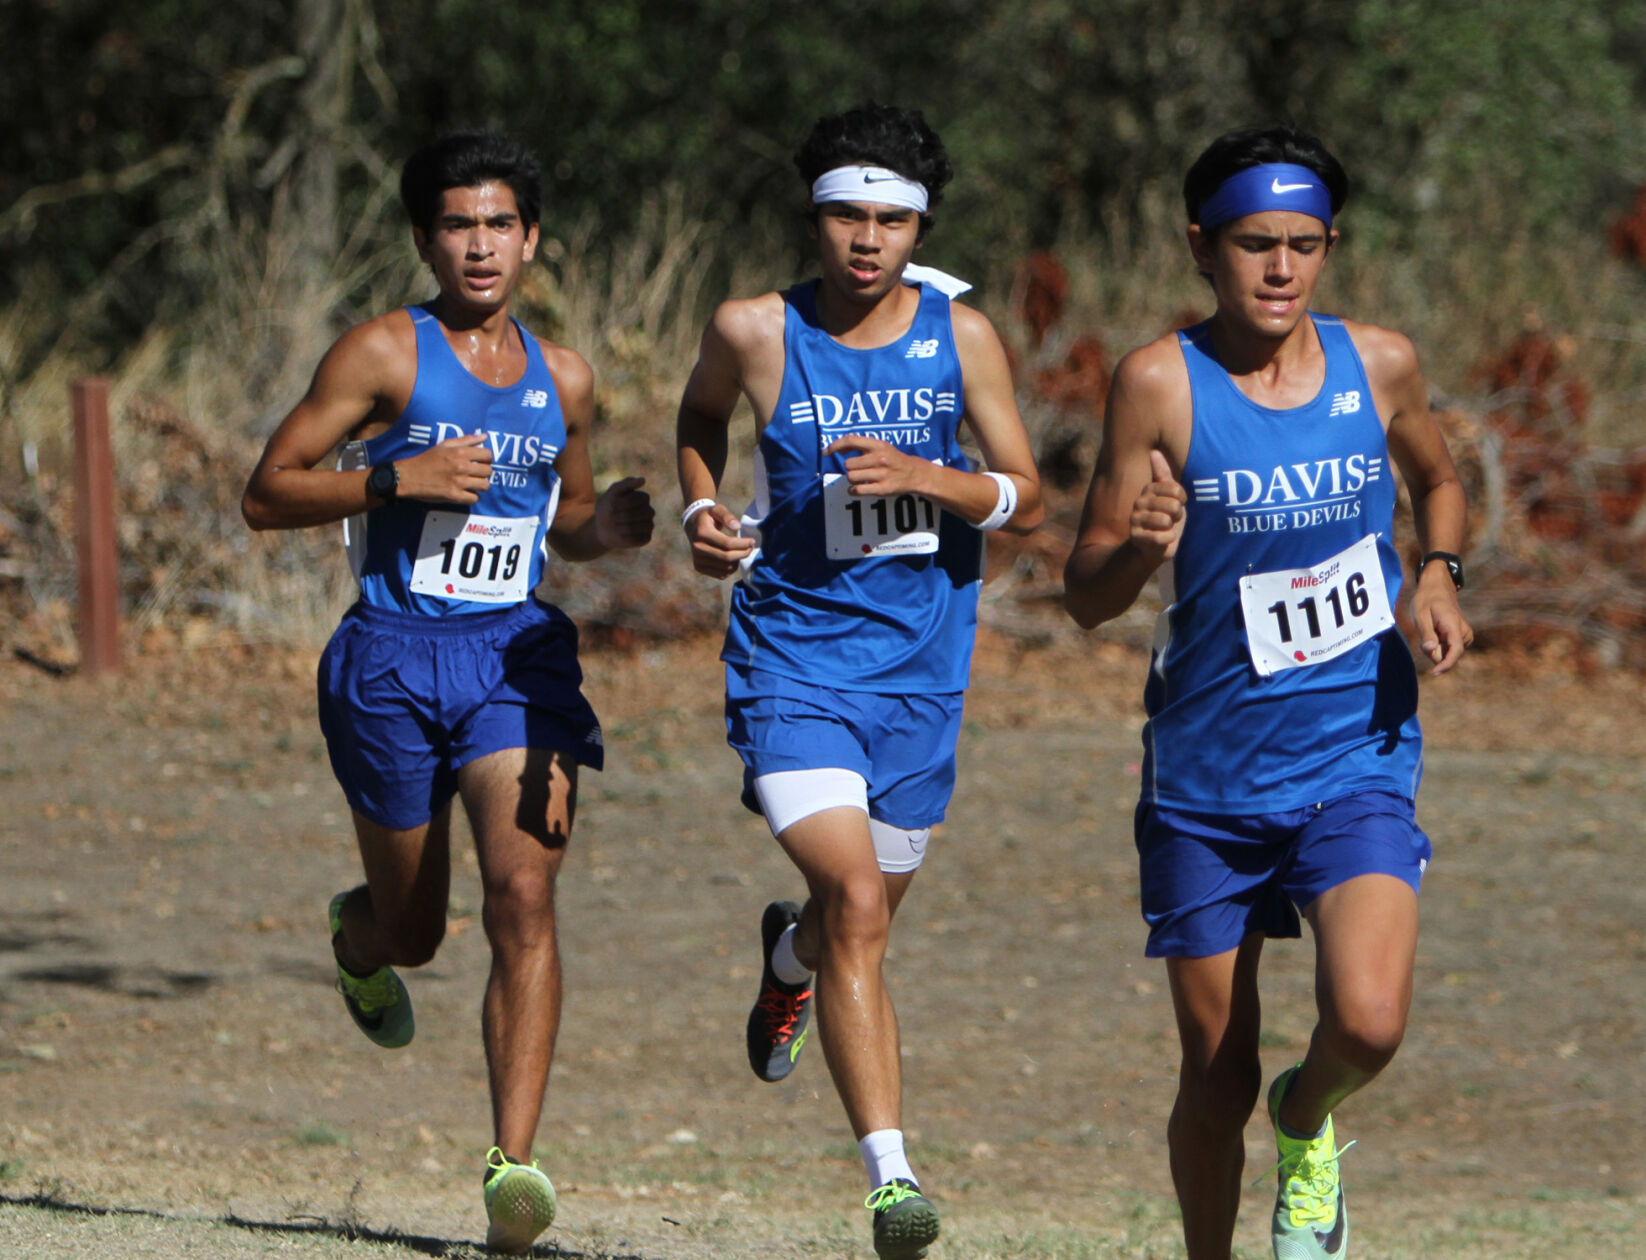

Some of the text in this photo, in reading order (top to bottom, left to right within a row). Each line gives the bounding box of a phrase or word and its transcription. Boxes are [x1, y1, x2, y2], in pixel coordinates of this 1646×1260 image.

[812, 388, 934, 426] DAVIS
[488, 470, 528, 488] EVILS
[1222, 454, 1366, 507] DAVIS
[845, 494, 935, 536] 1101
[1227, 500, 1361, 533] BLUE DEVILS
[440, 538, 521, 581] 1019
[1291, 562, 1340, 589] MileSplit
[1268, 571, 1369, 643] 1116
